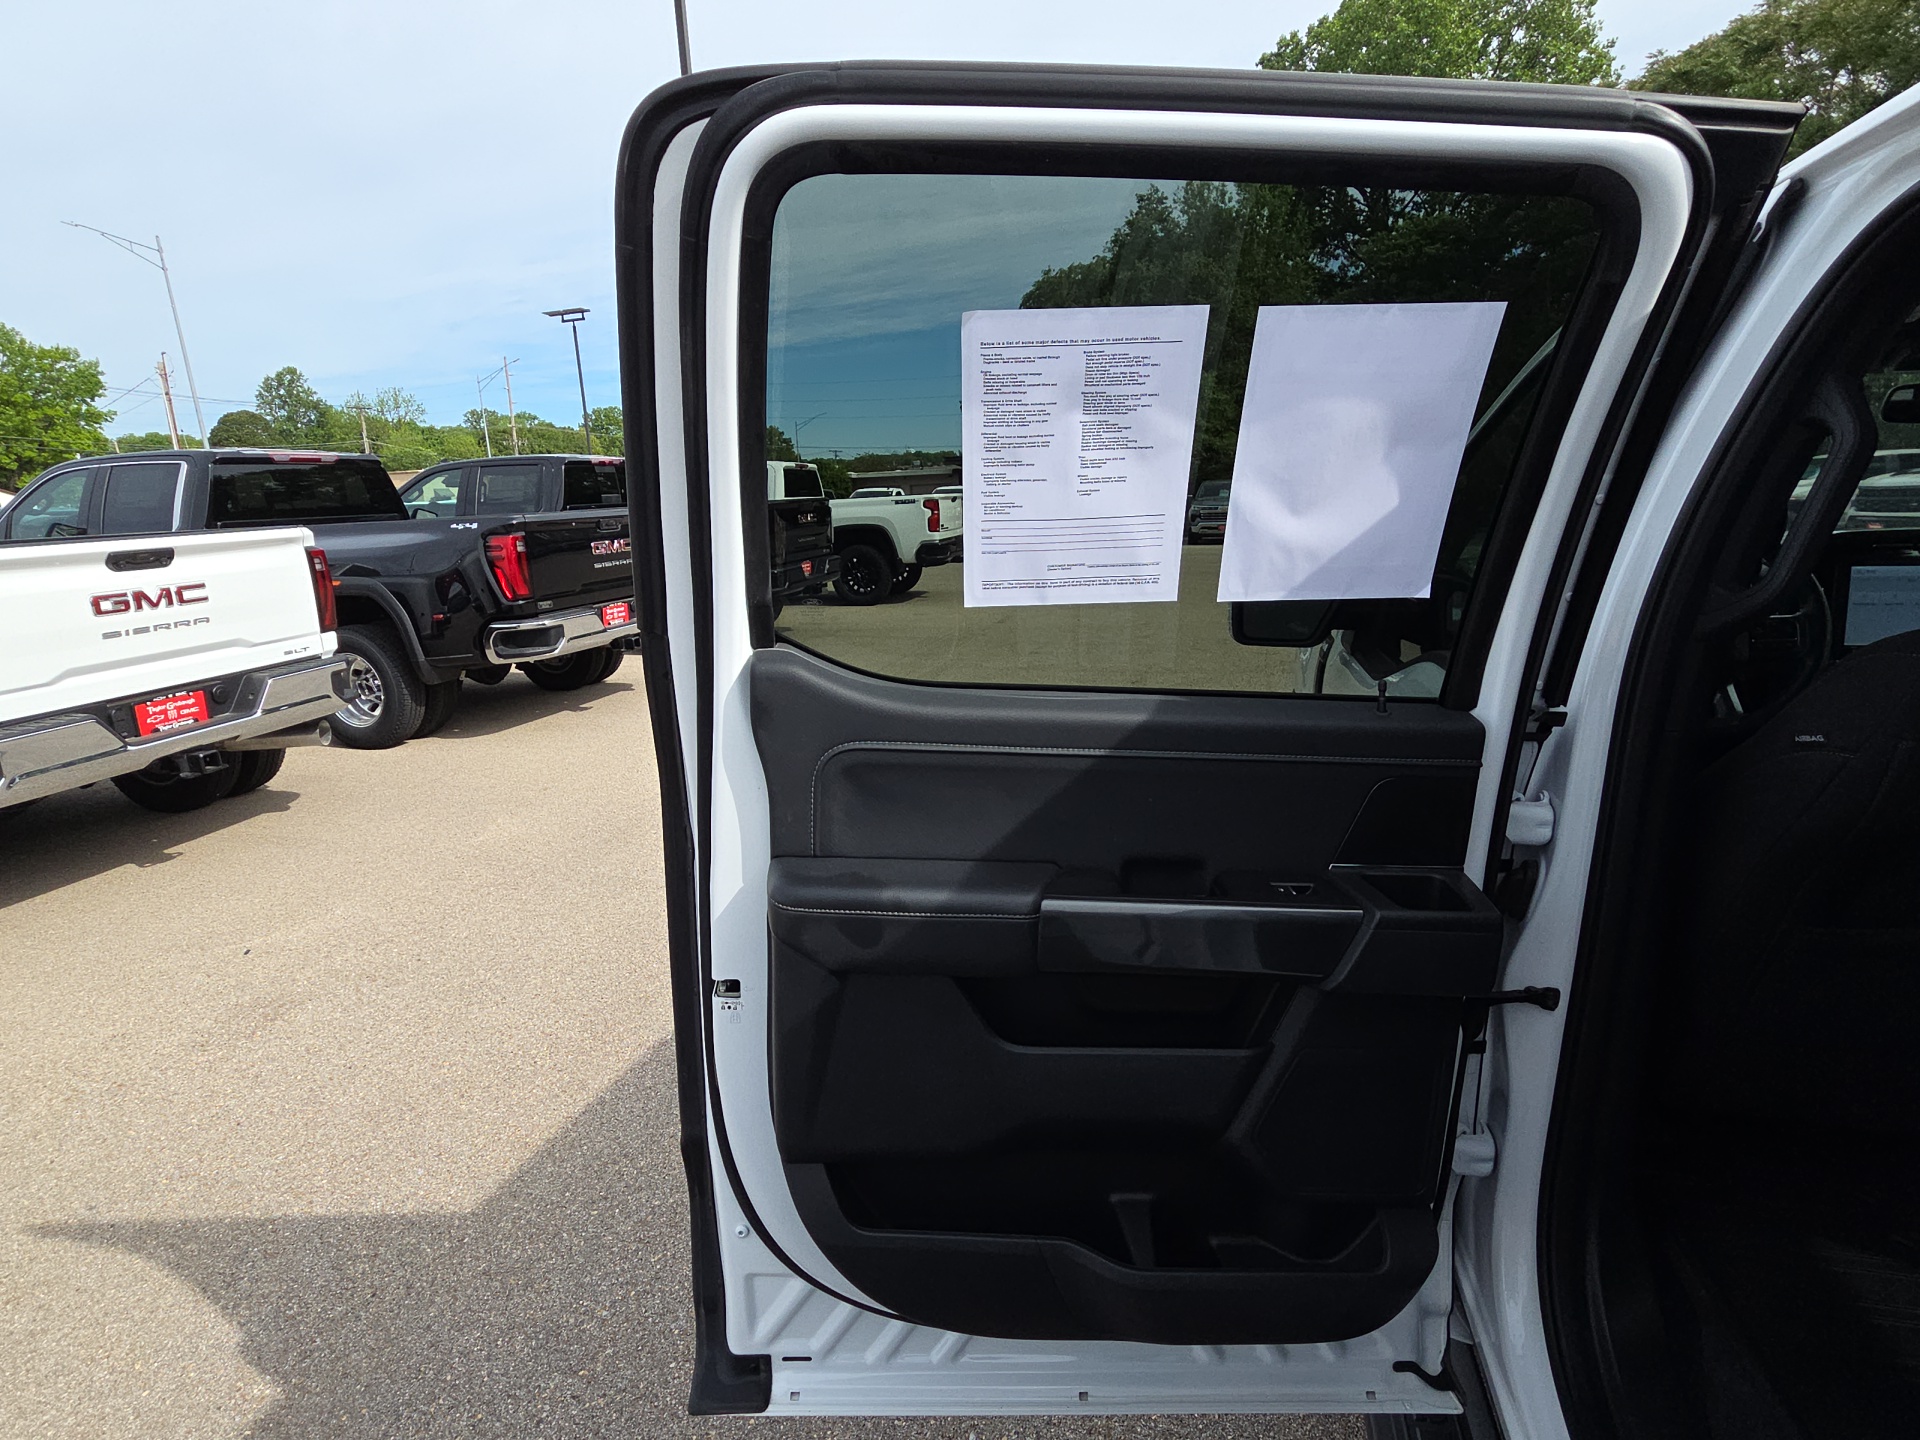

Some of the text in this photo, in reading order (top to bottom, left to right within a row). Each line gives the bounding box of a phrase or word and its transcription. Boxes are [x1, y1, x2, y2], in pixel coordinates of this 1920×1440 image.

[89, 580, 209, 617] GMC
[102, 616, 210, 640] SIERRA
[284, 647, 310, 655] SLT
